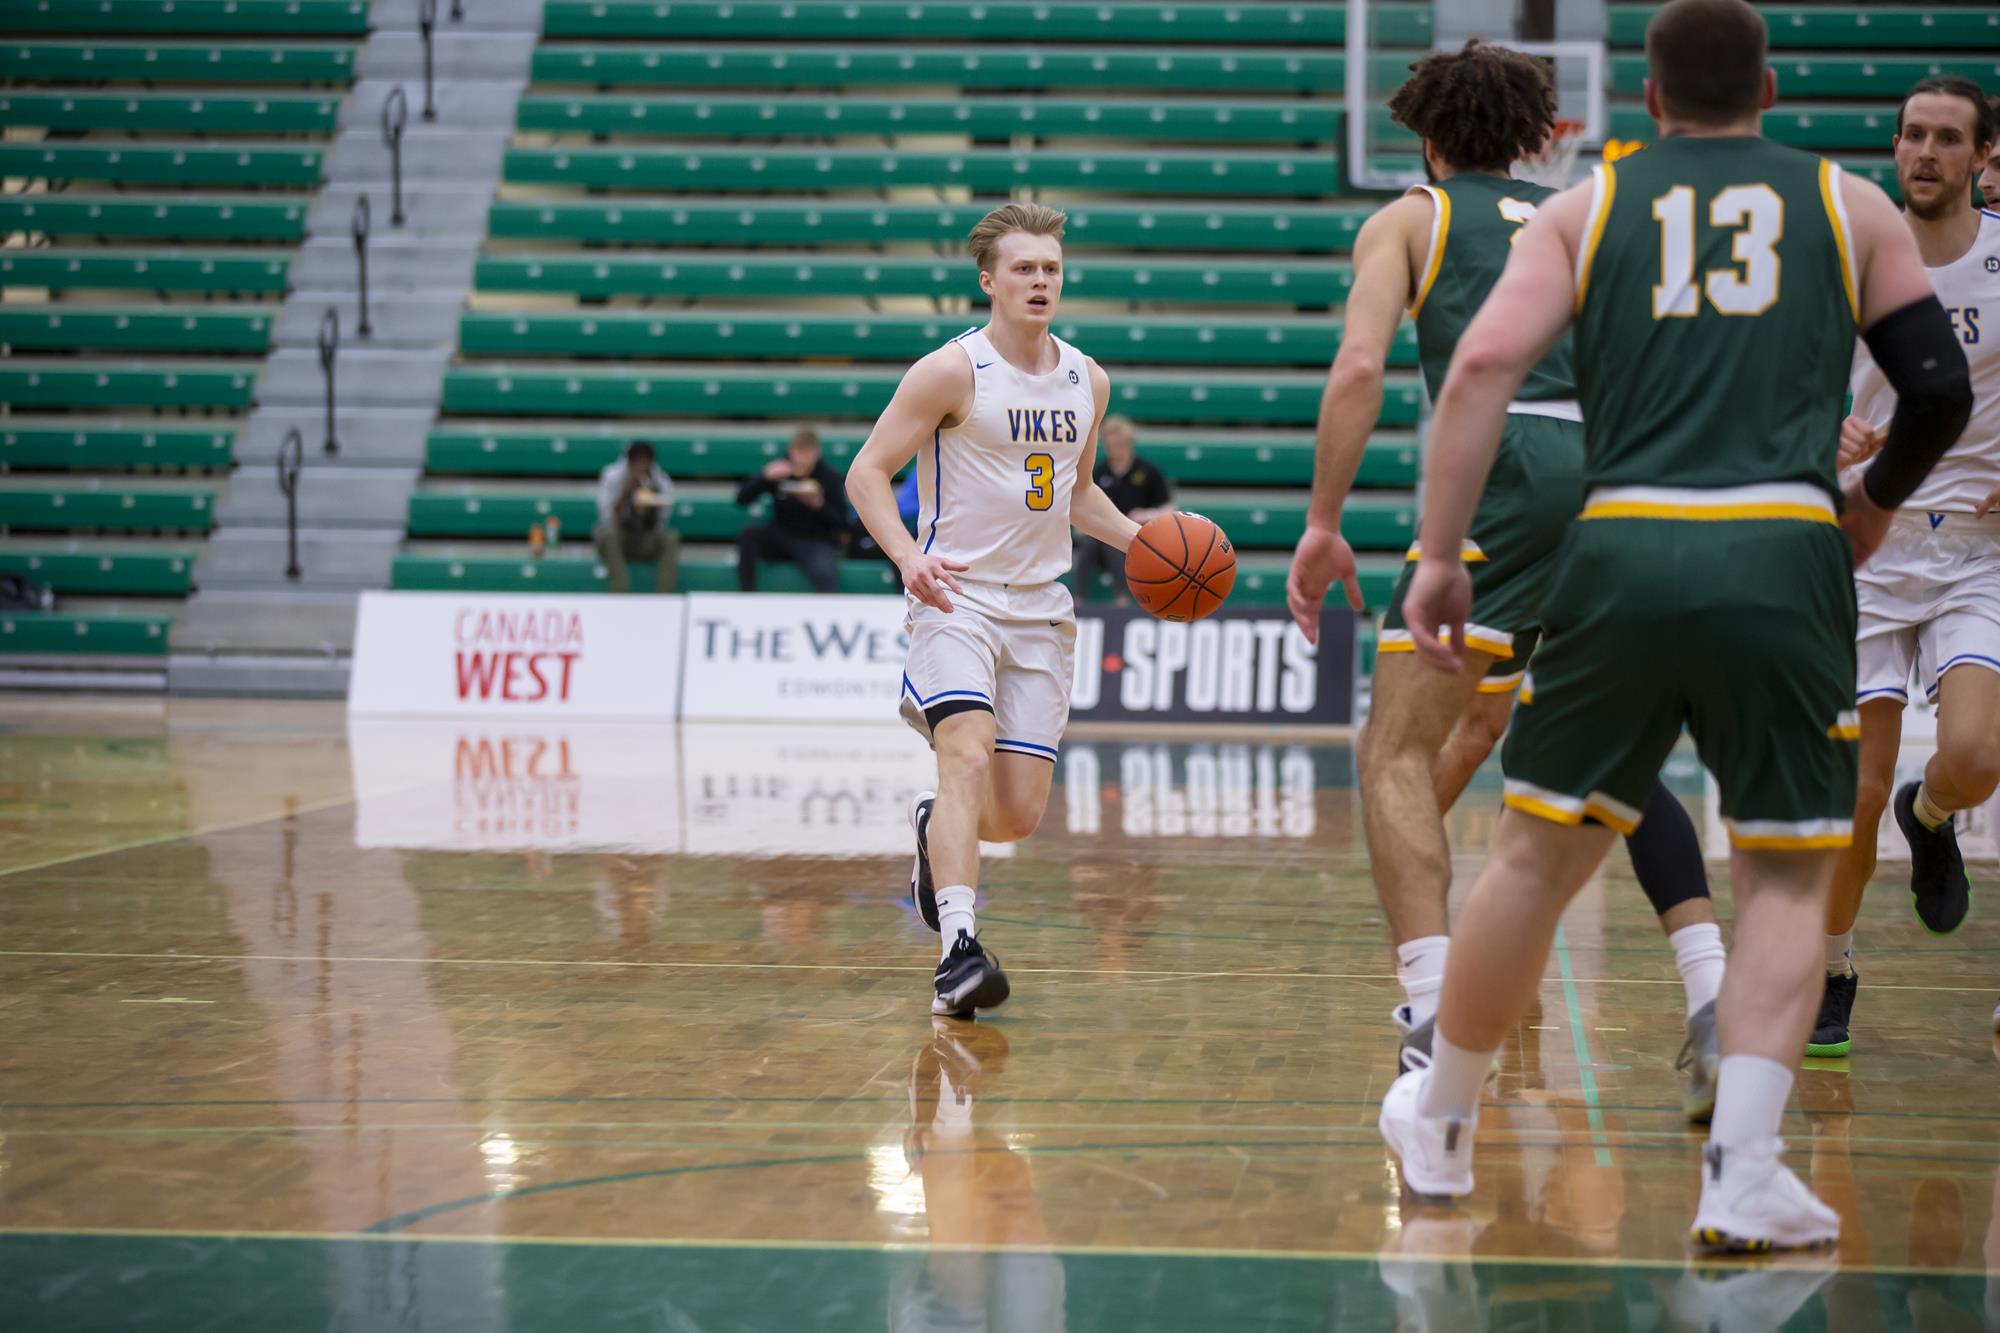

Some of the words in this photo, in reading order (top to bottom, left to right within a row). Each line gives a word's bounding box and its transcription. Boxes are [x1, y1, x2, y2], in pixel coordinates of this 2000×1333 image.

[1651, 182, 1785, 320] 13
[1986, 258, 1999, 271] 13
[1008, 409, 1077, 443] VIKES
[1025, 453, 1054, 511] 3
[455, 608, 583, 644] CANADA
[456, 651, 582, 702] WEST
[1121, 618, 1318, 713] SPORTS
